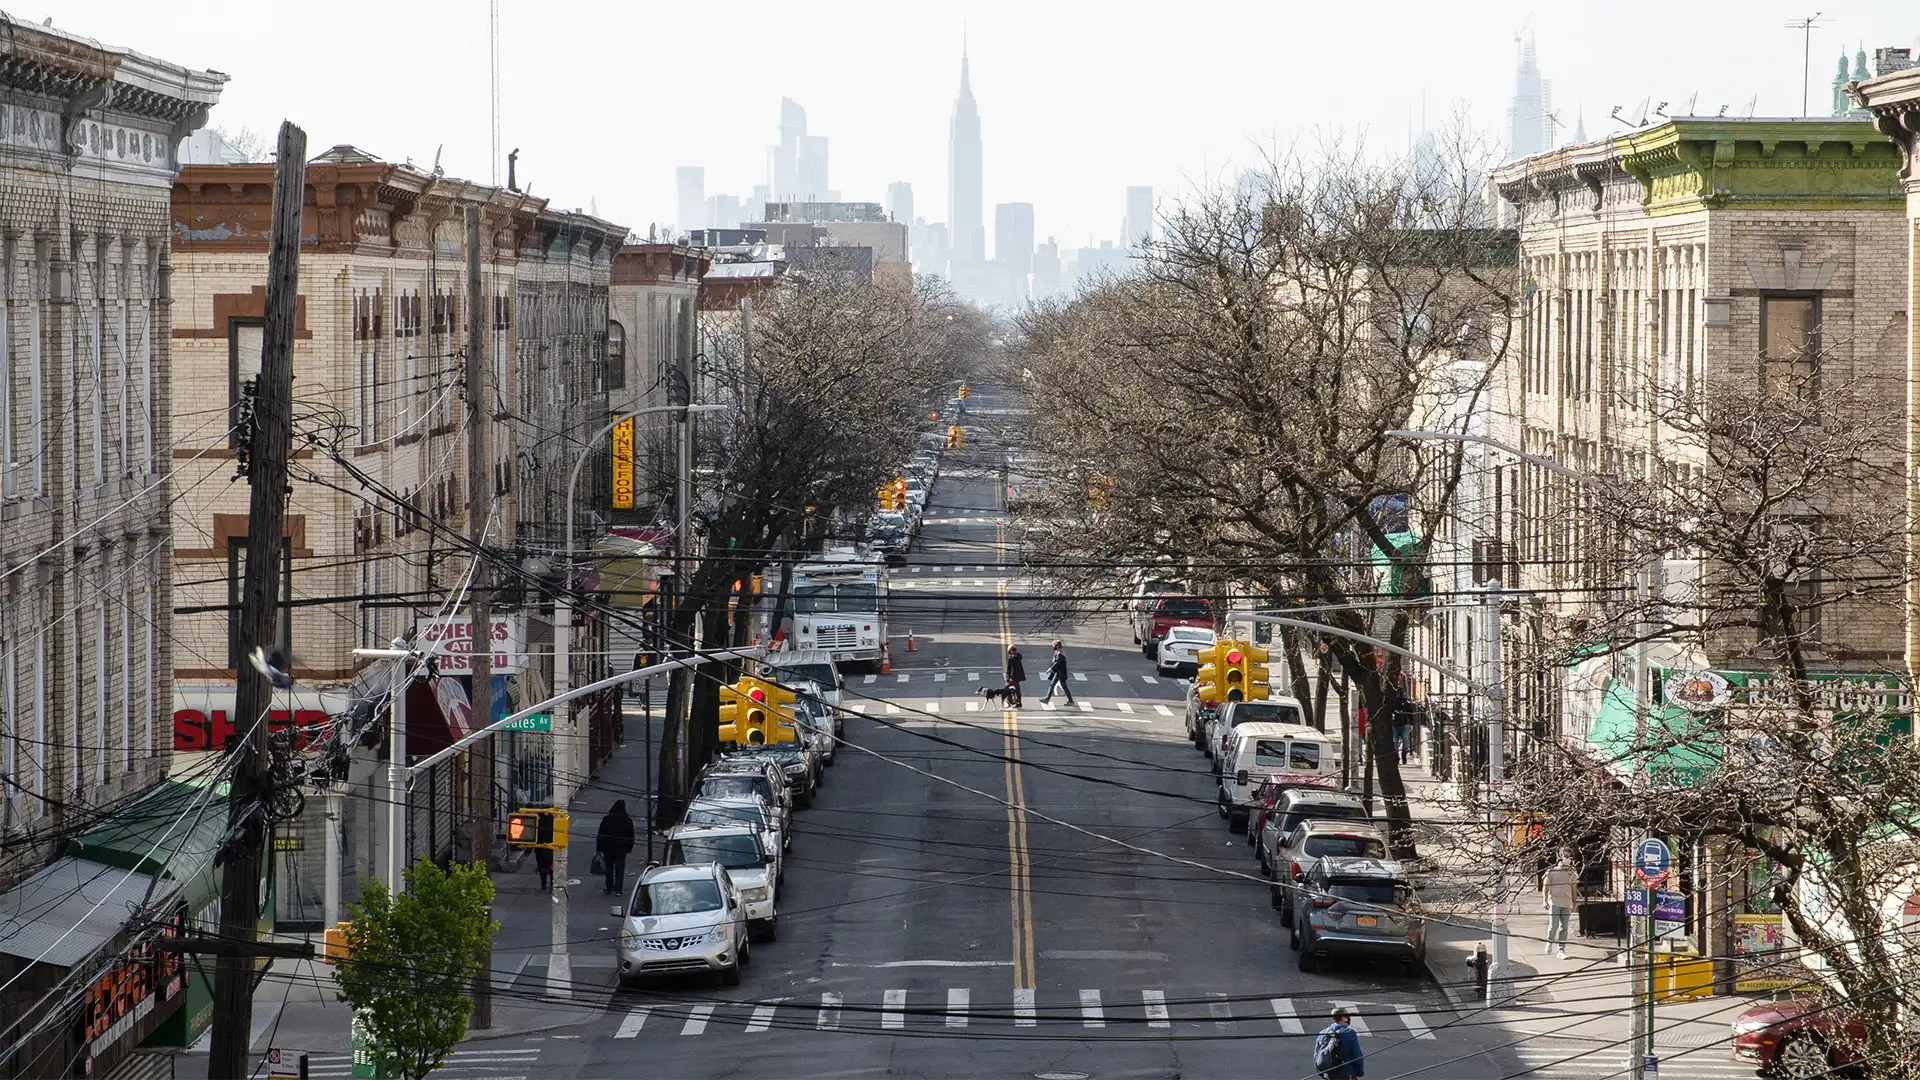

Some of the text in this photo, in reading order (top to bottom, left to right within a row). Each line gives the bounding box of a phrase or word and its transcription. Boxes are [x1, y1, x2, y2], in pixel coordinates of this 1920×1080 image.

[616, 471, 631, 502] FOOD
[451, 641, 473, 652] AT
[438, 651, 508, 670] ASD
[540, 717, 549, 725] Av
